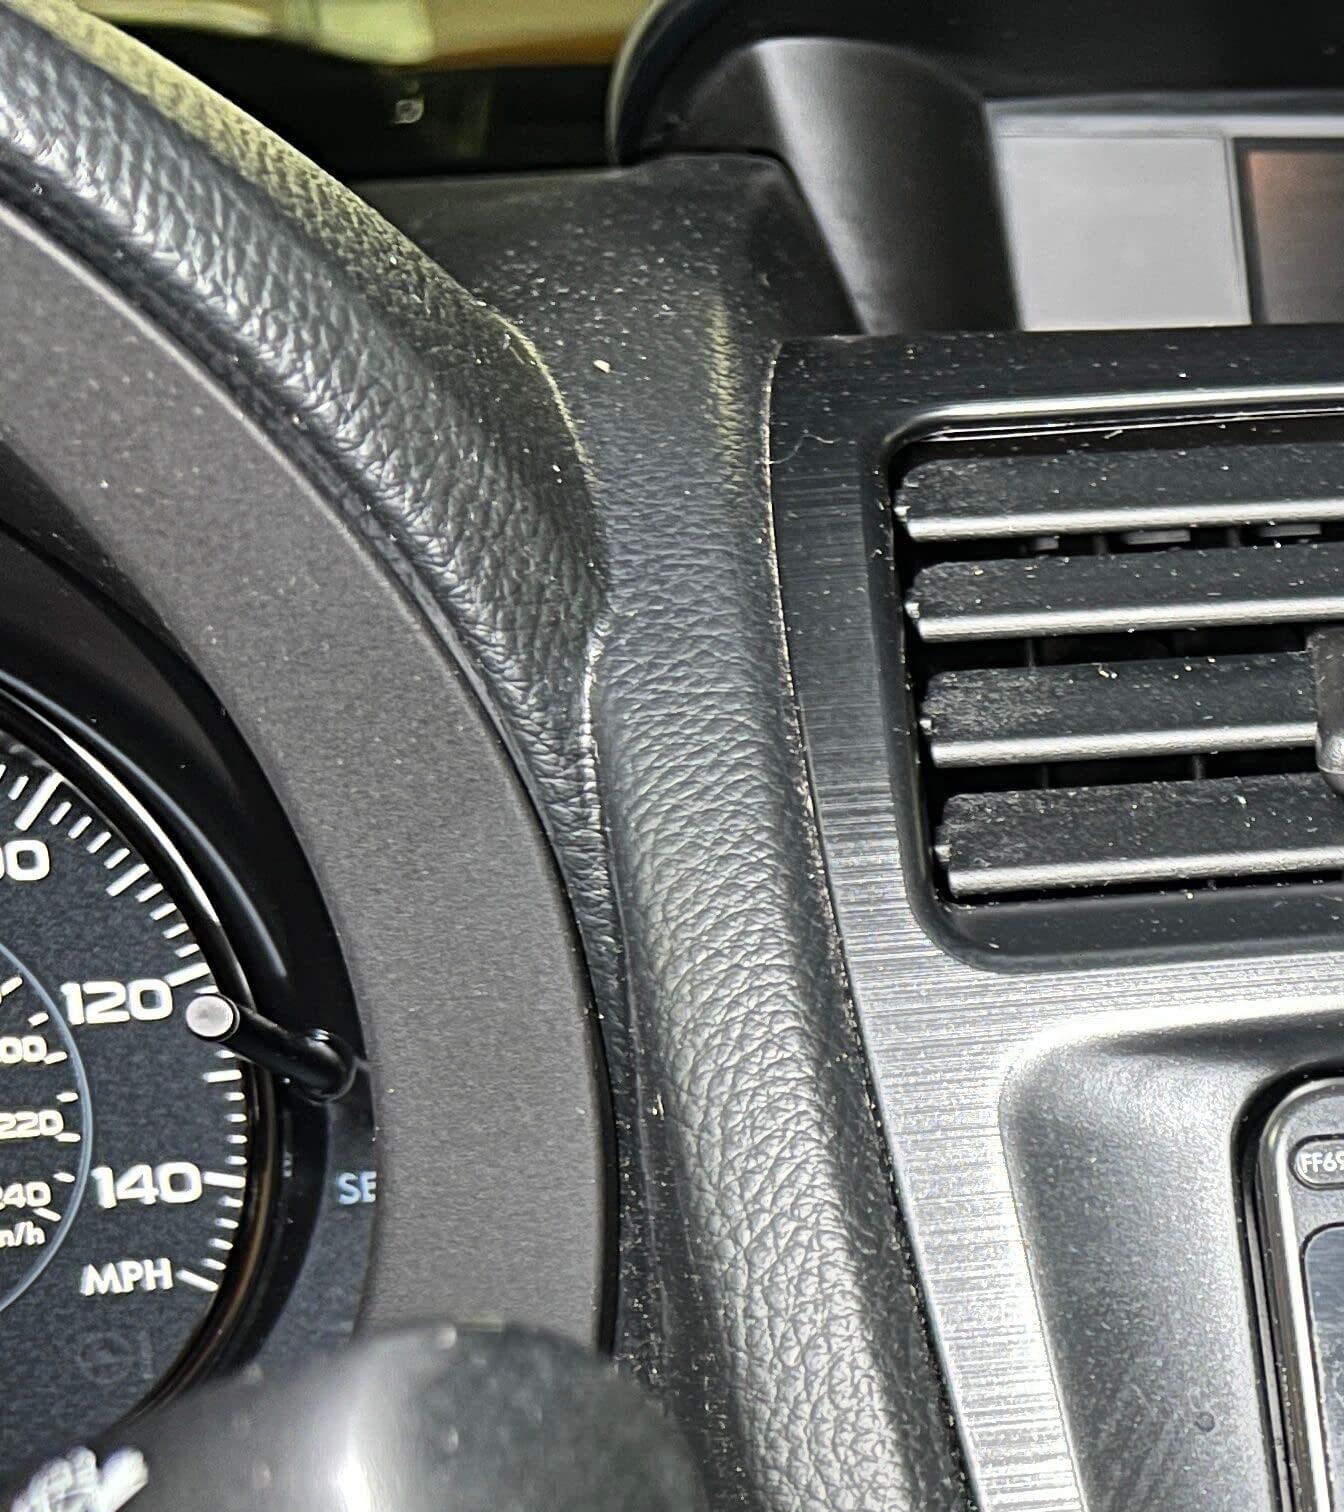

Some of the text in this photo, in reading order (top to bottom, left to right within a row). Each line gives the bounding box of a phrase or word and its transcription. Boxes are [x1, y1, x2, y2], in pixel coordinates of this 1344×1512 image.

[60, 978, 174, 1026] 120
[0, 1181, 52, 1210] 40
[91, 1161, 203, 1209] 140
[338, 1170, 377, 1205] SE
[79, 1256, 174, 1297] MPH
